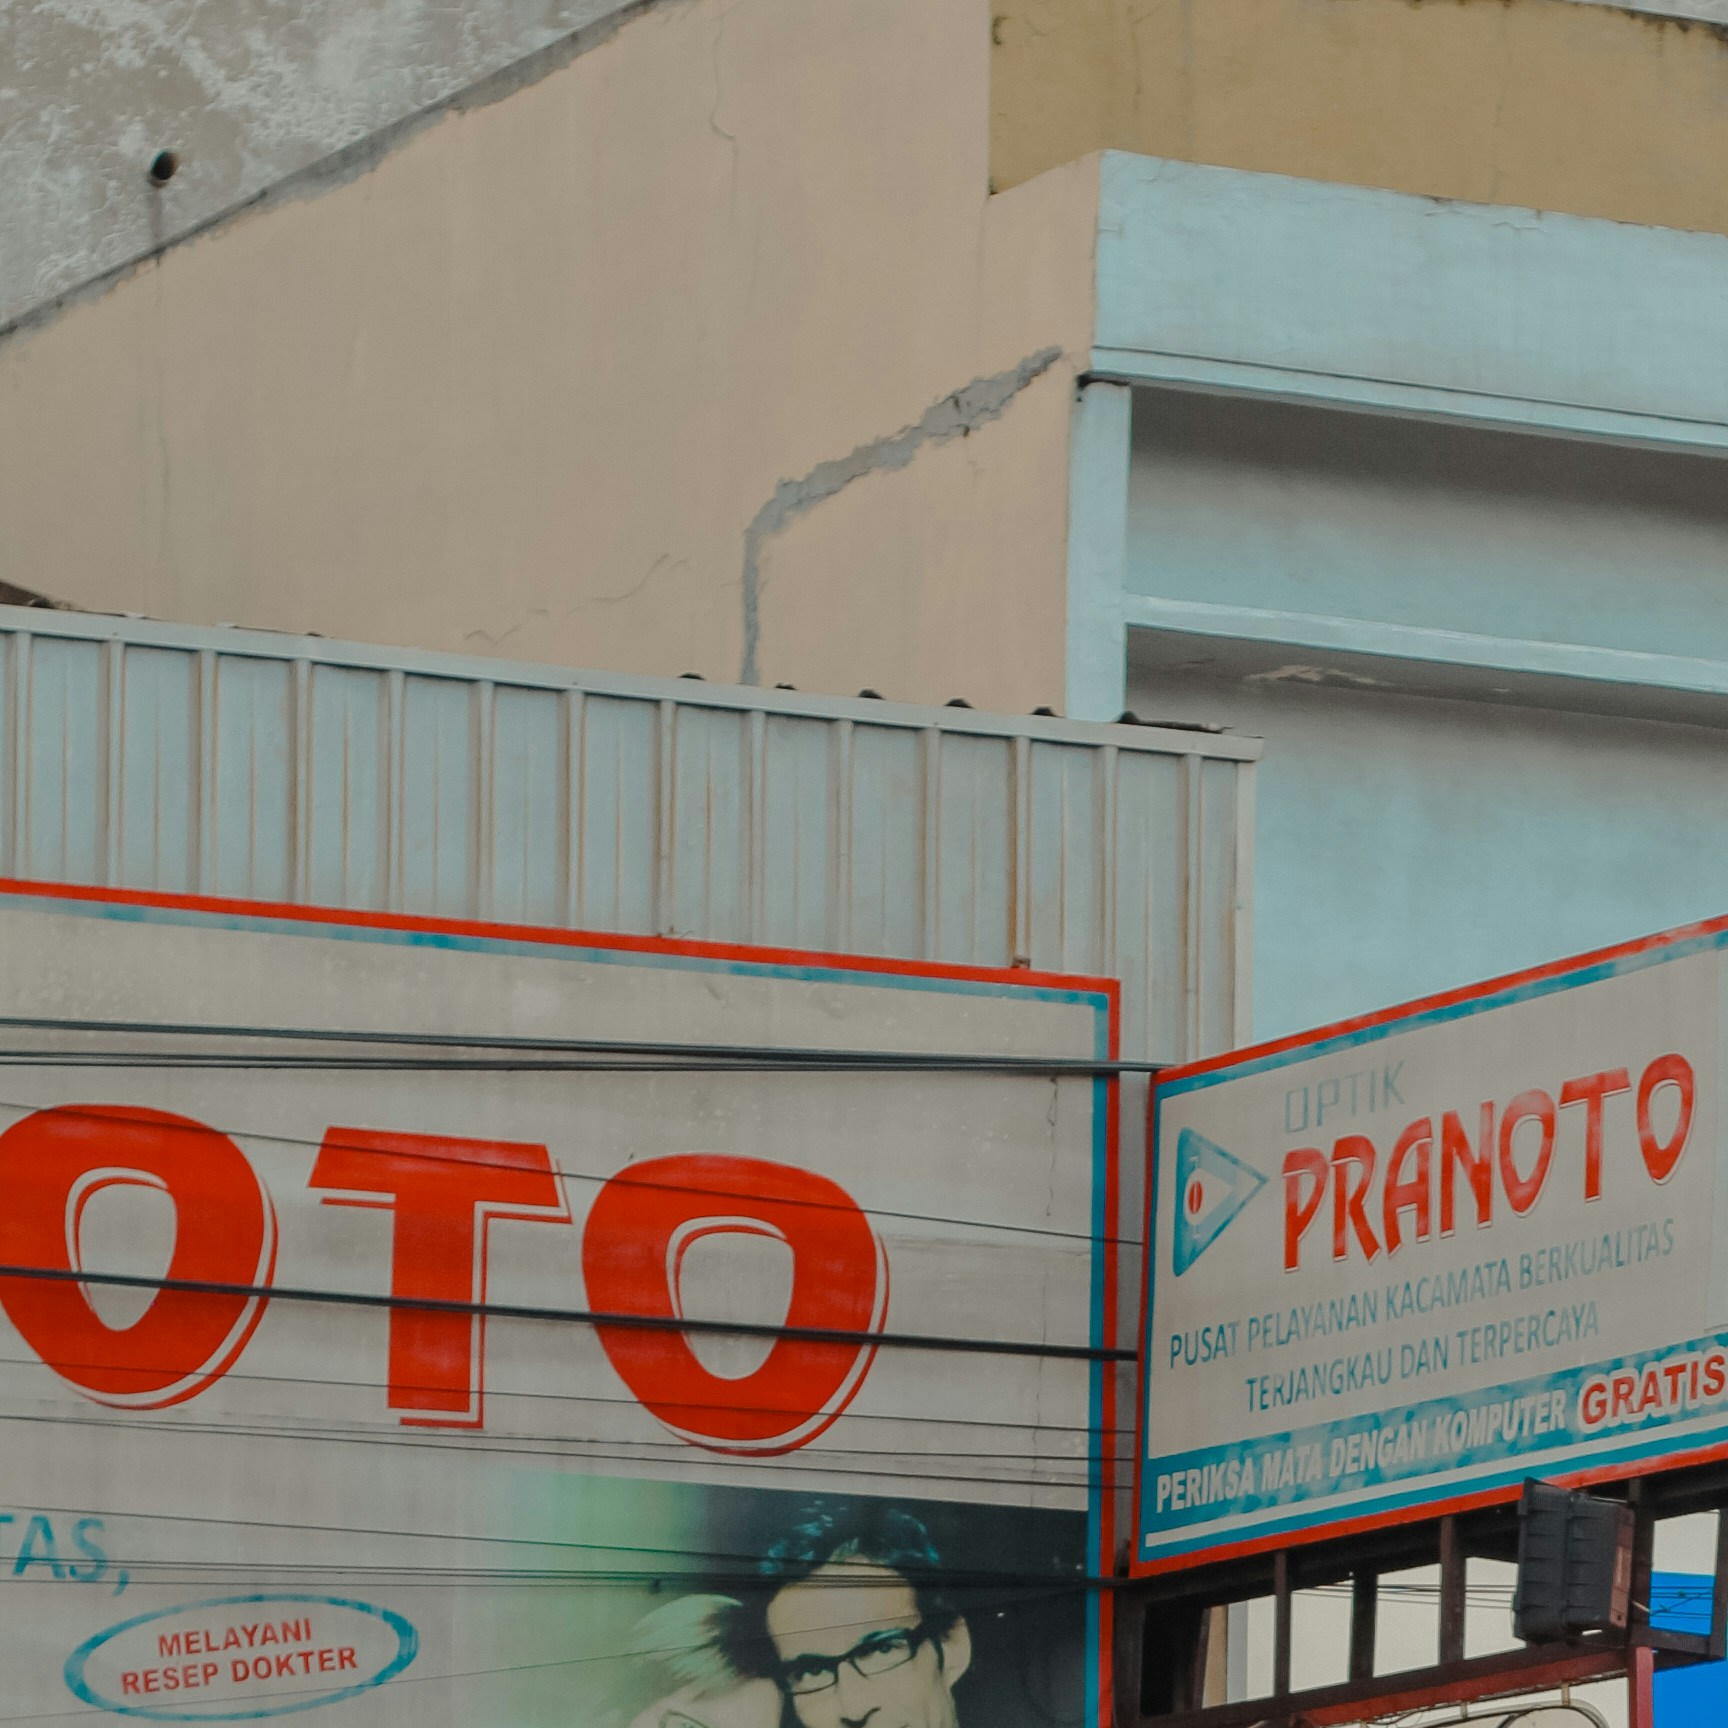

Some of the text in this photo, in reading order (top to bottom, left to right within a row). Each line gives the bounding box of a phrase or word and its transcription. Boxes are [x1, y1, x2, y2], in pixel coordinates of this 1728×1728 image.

[1285, 1060, 1405, 1133] OPTIK
[1282, 1053, 1697, 1274] PRANOTO
[1170, 1218, 1675, 1369] PUSAT PELAYANAN KACAMATA BERKUALITAS
[1246, 1301, 1600, 1412] TERJANGKAU DAN TERPERCAYA
[1157, 1456, 1254, 1513] PERIKSA
[1261, 1441, 1324, 1491] MATA
[1329, 1419, 1426, 1477] DENGAN
[1432, 1389, 1567, 1453] KOMPUTER
[120, 1646, 358, 1696] RESEP DOKTER
[157, 1618, 312, 1658] MELAYANI
